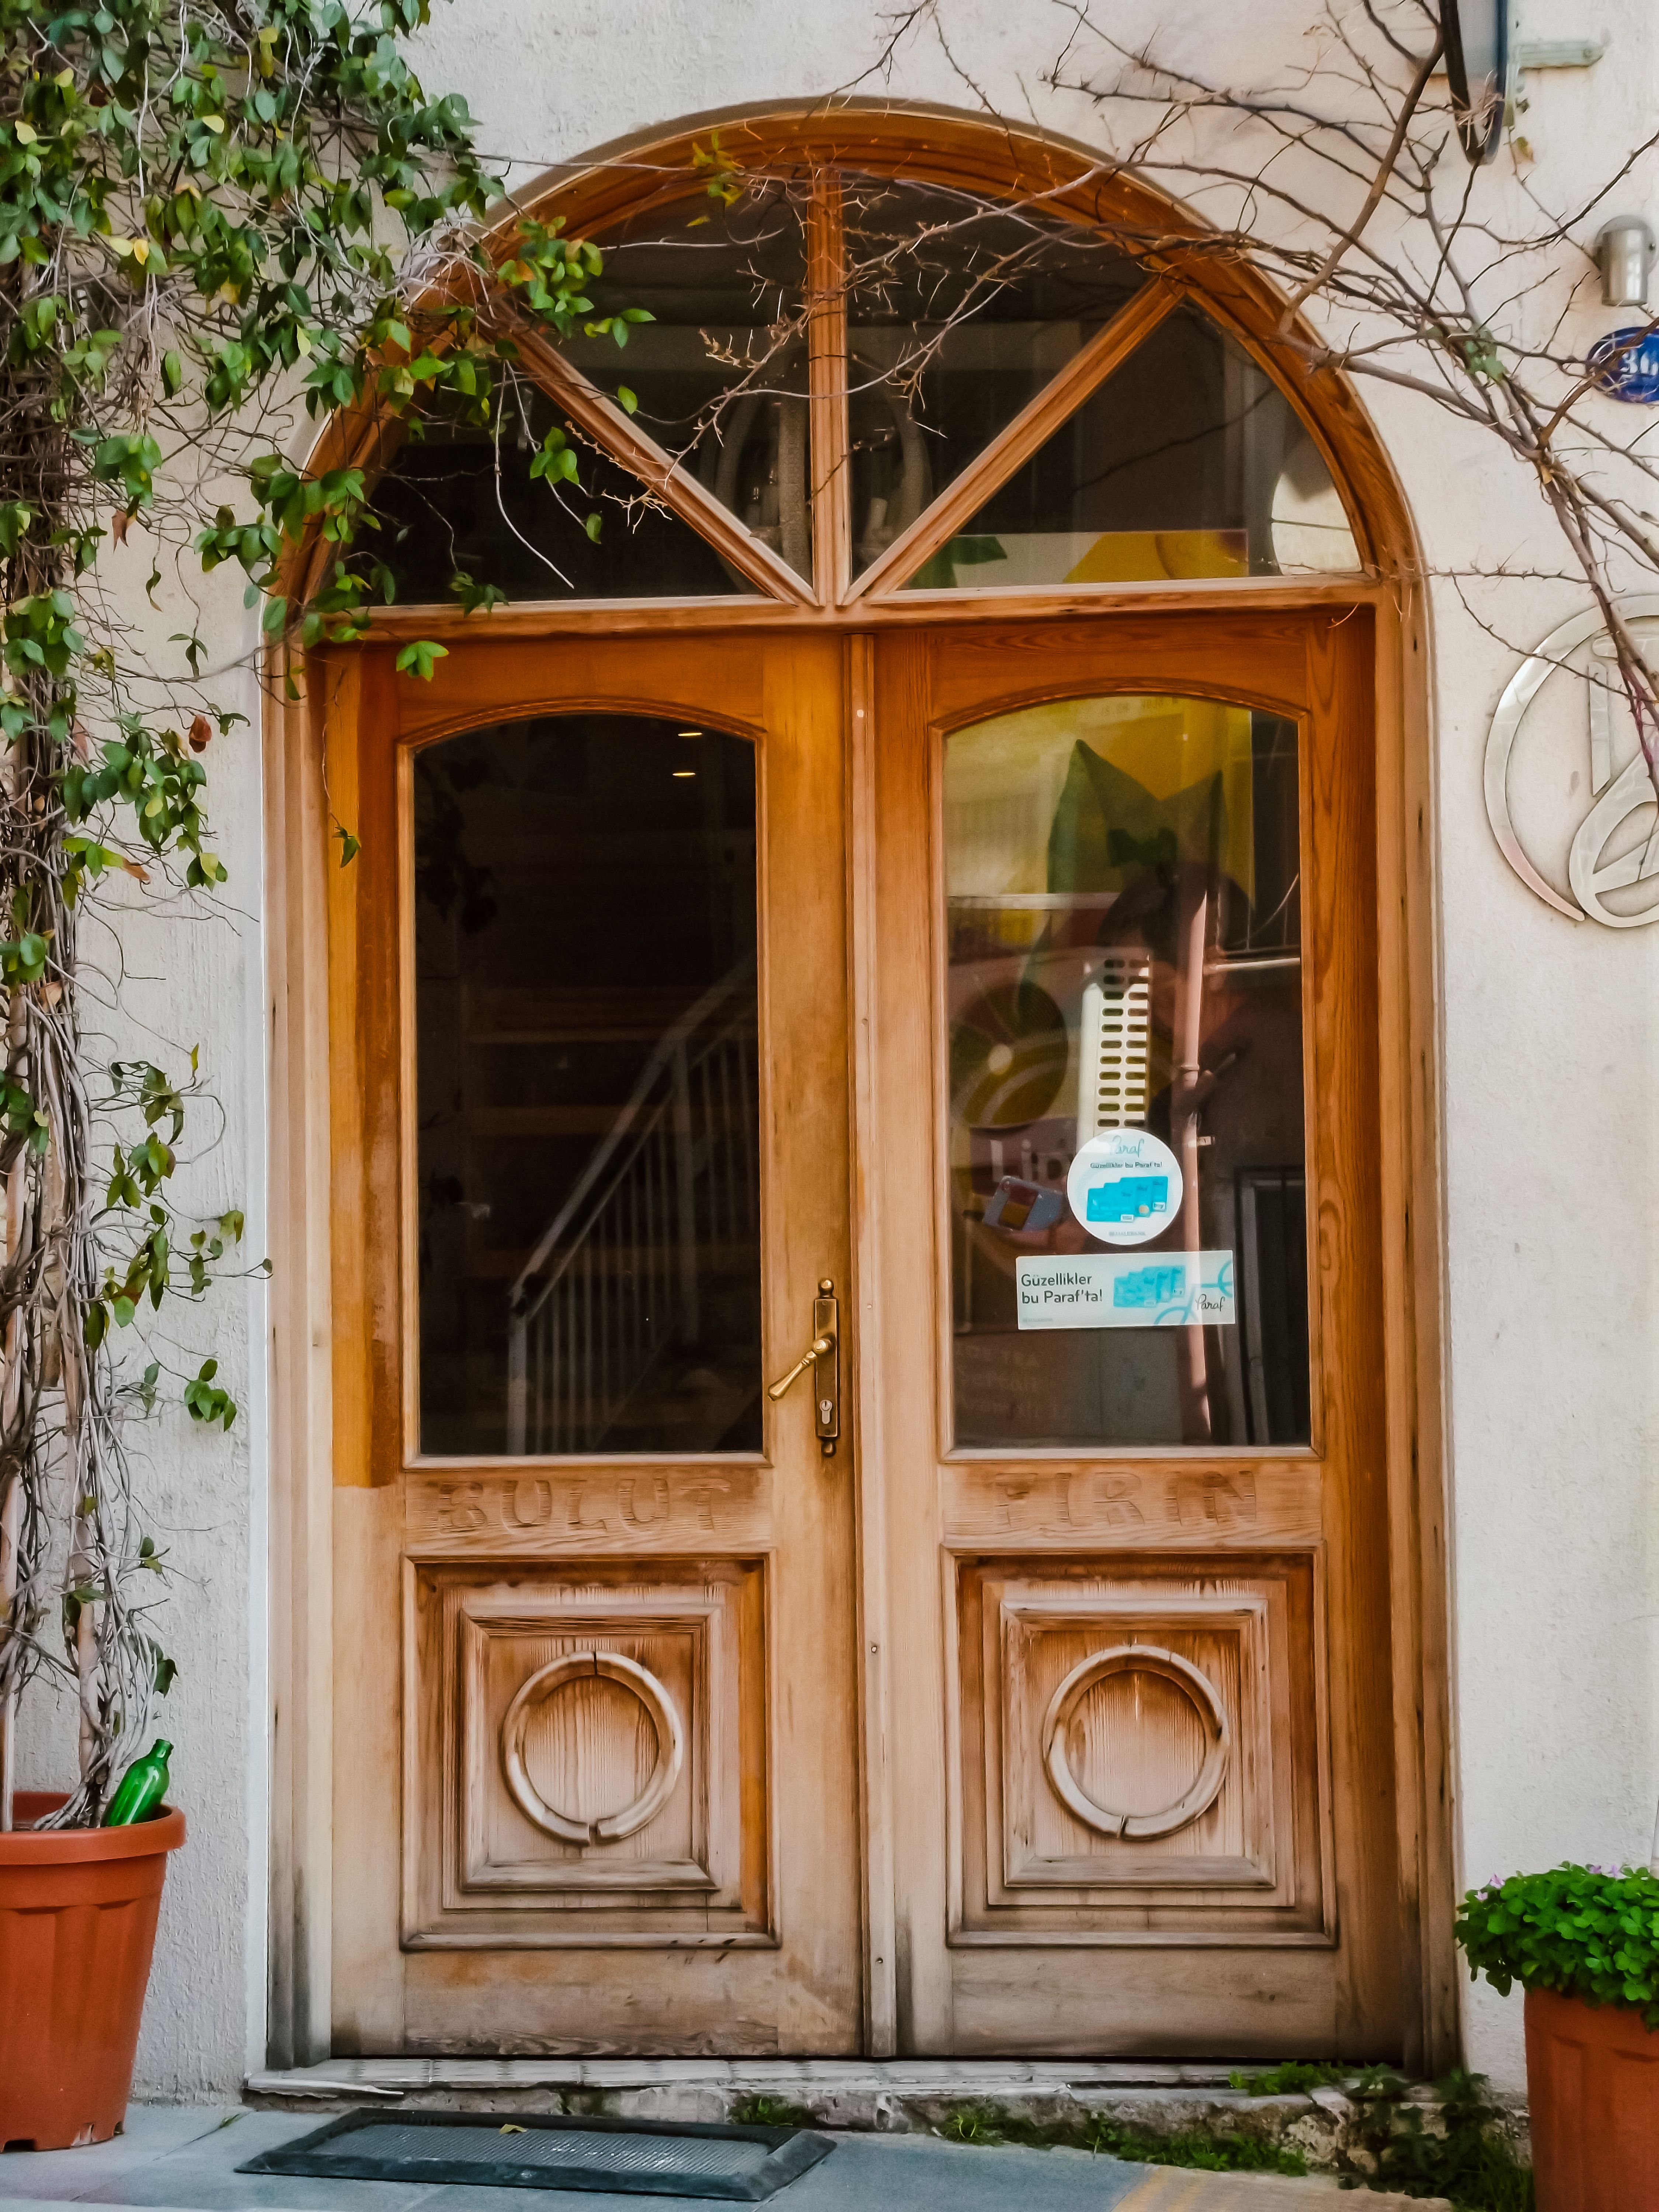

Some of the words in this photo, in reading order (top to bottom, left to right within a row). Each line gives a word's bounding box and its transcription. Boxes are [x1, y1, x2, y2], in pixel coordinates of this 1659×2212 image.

[1021, 1272, 1092, 1286] Güzellikler
[1022, 1291, 1039, 1304] bu
[1044, 1289, 1102, 1303] Paraf'ta!
[1196, 1294, 1225, 1311] Paraf
[438, 1478, 731, 1534] BULUT
